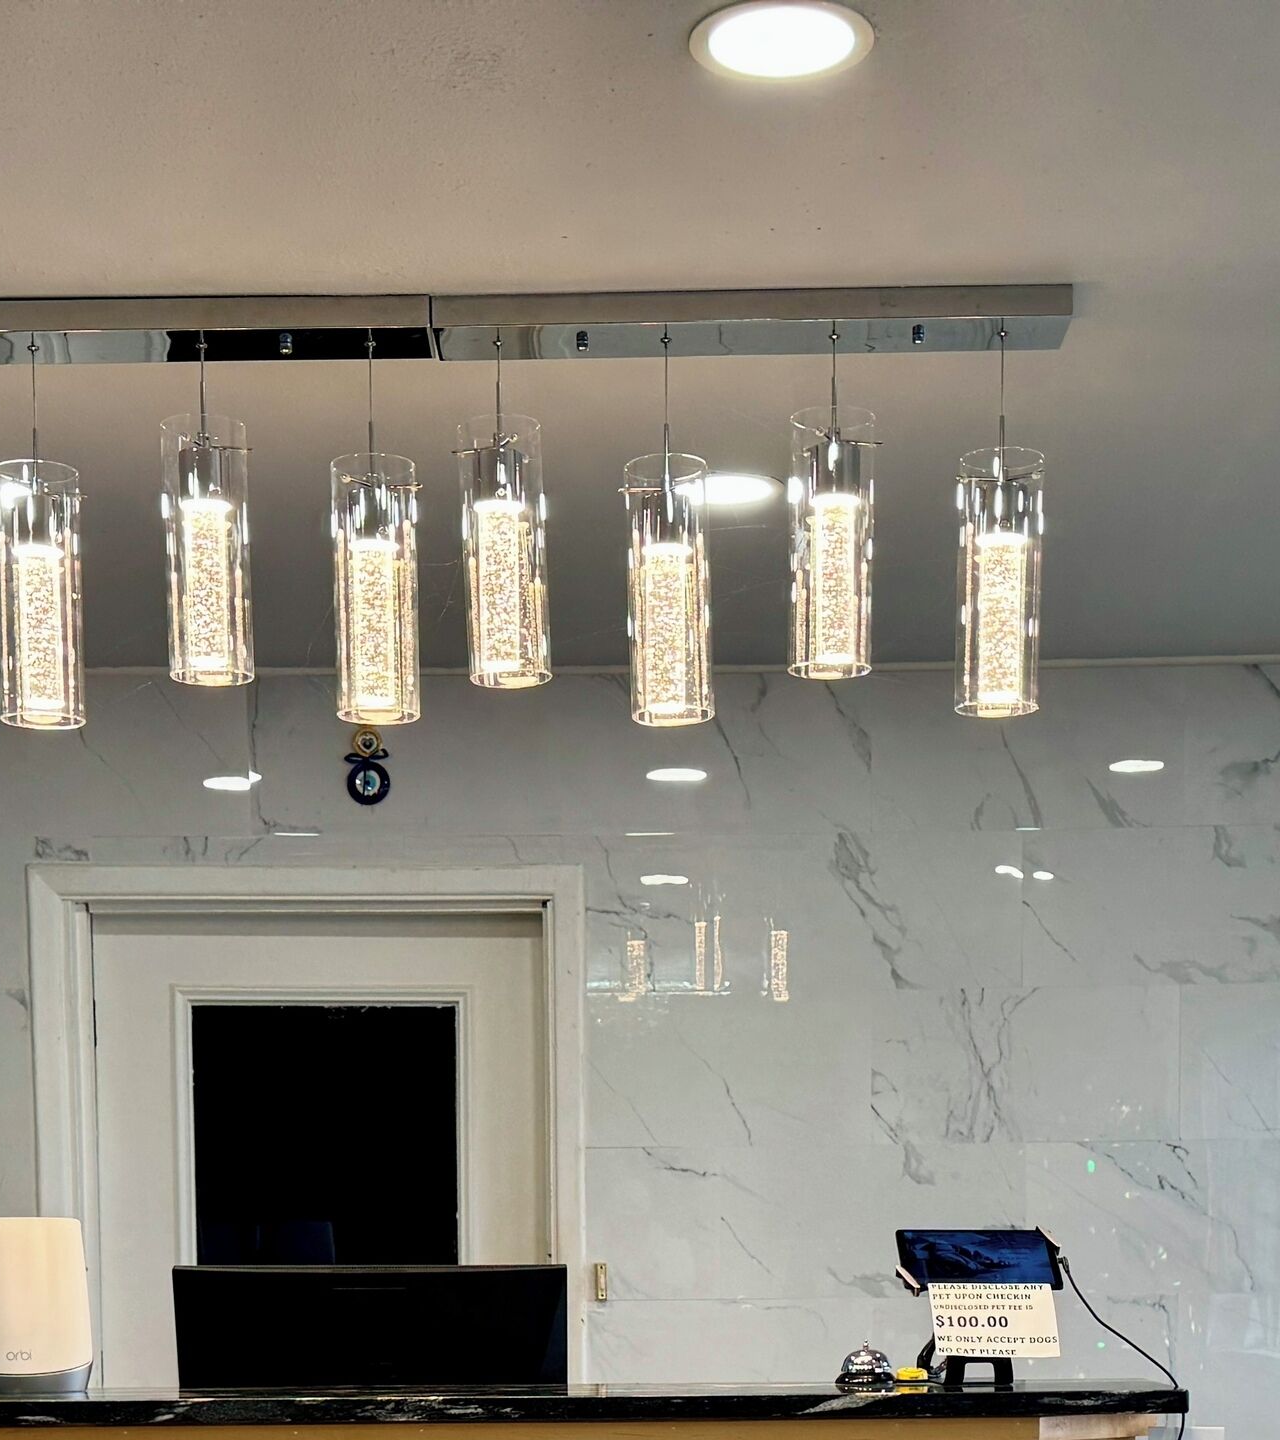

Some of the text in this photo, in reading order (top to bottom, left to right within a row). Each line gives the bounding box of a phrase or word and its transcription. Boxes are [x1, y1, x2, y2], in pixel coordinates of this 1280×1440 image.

[935, 1315, 1009, 1328] $100.00
[955, 1335, 983, 1343] ONLY
[986, 1336, 1026, 1344] ACCEPT
[1029, 1336, 1058, 1344] DOGS
[5, 1348, 33, 1361] orbi
[955, 1347, 977, 1355] CAT
[980, 1348, 1017, 1356] PLEASE
